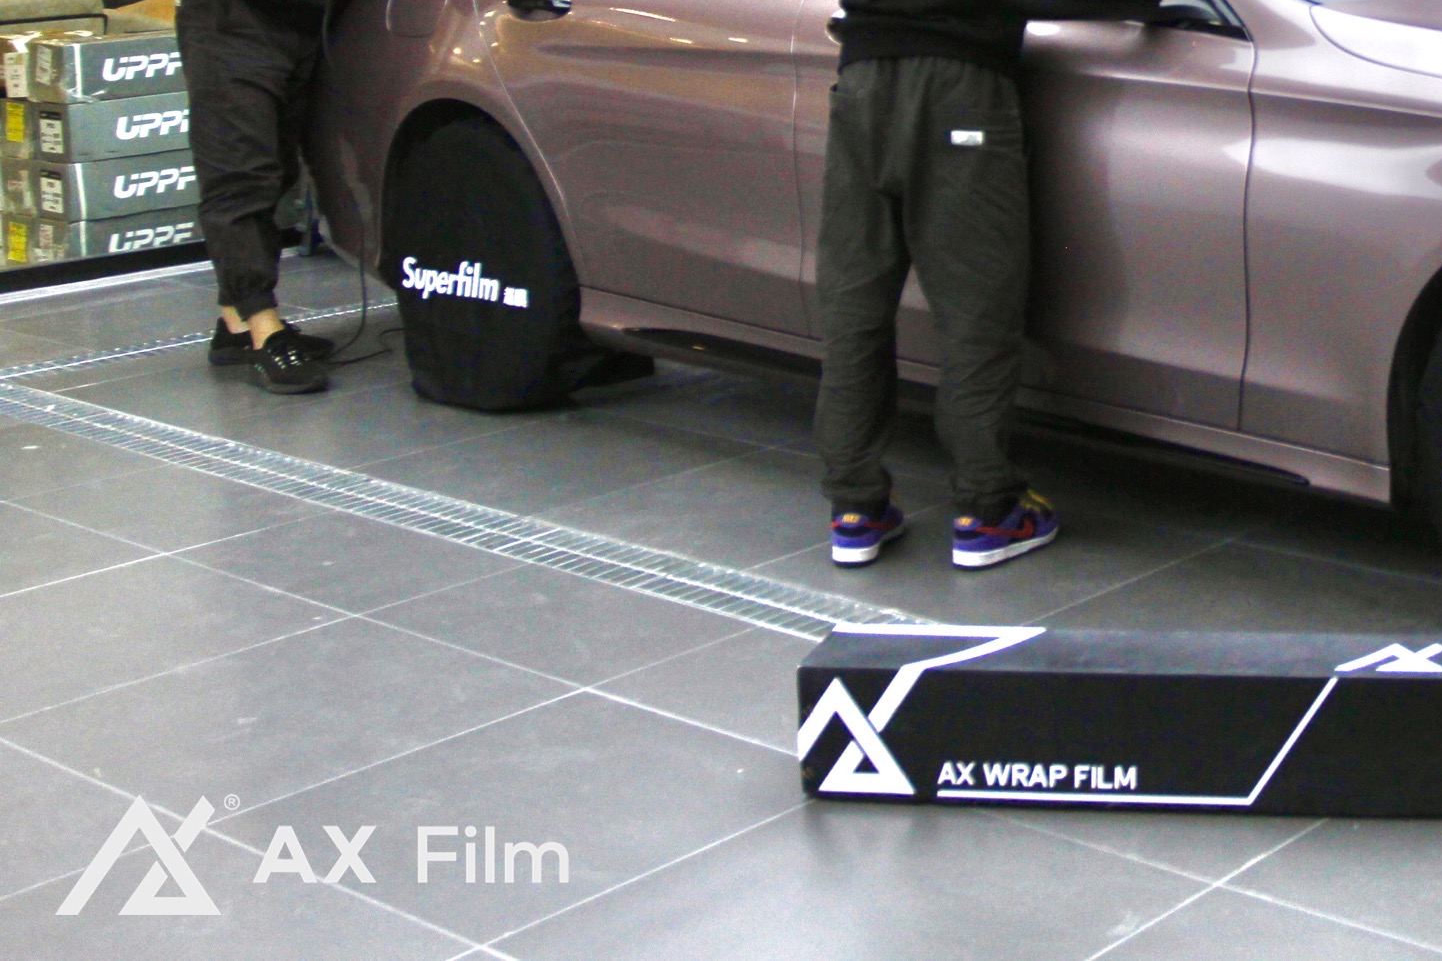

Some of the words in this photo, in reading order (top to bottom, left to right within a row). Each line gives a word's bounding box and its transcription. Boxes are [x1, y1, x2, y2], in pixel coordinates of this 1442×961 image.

[113, 165, 197, 199] UPPF
[402, 256, 499, 300] Superfilm
[937, 761, 975, 786] AX
[983, 762, 1068, 788] WRAP
[1073, 764, 1137, 790] FILM
